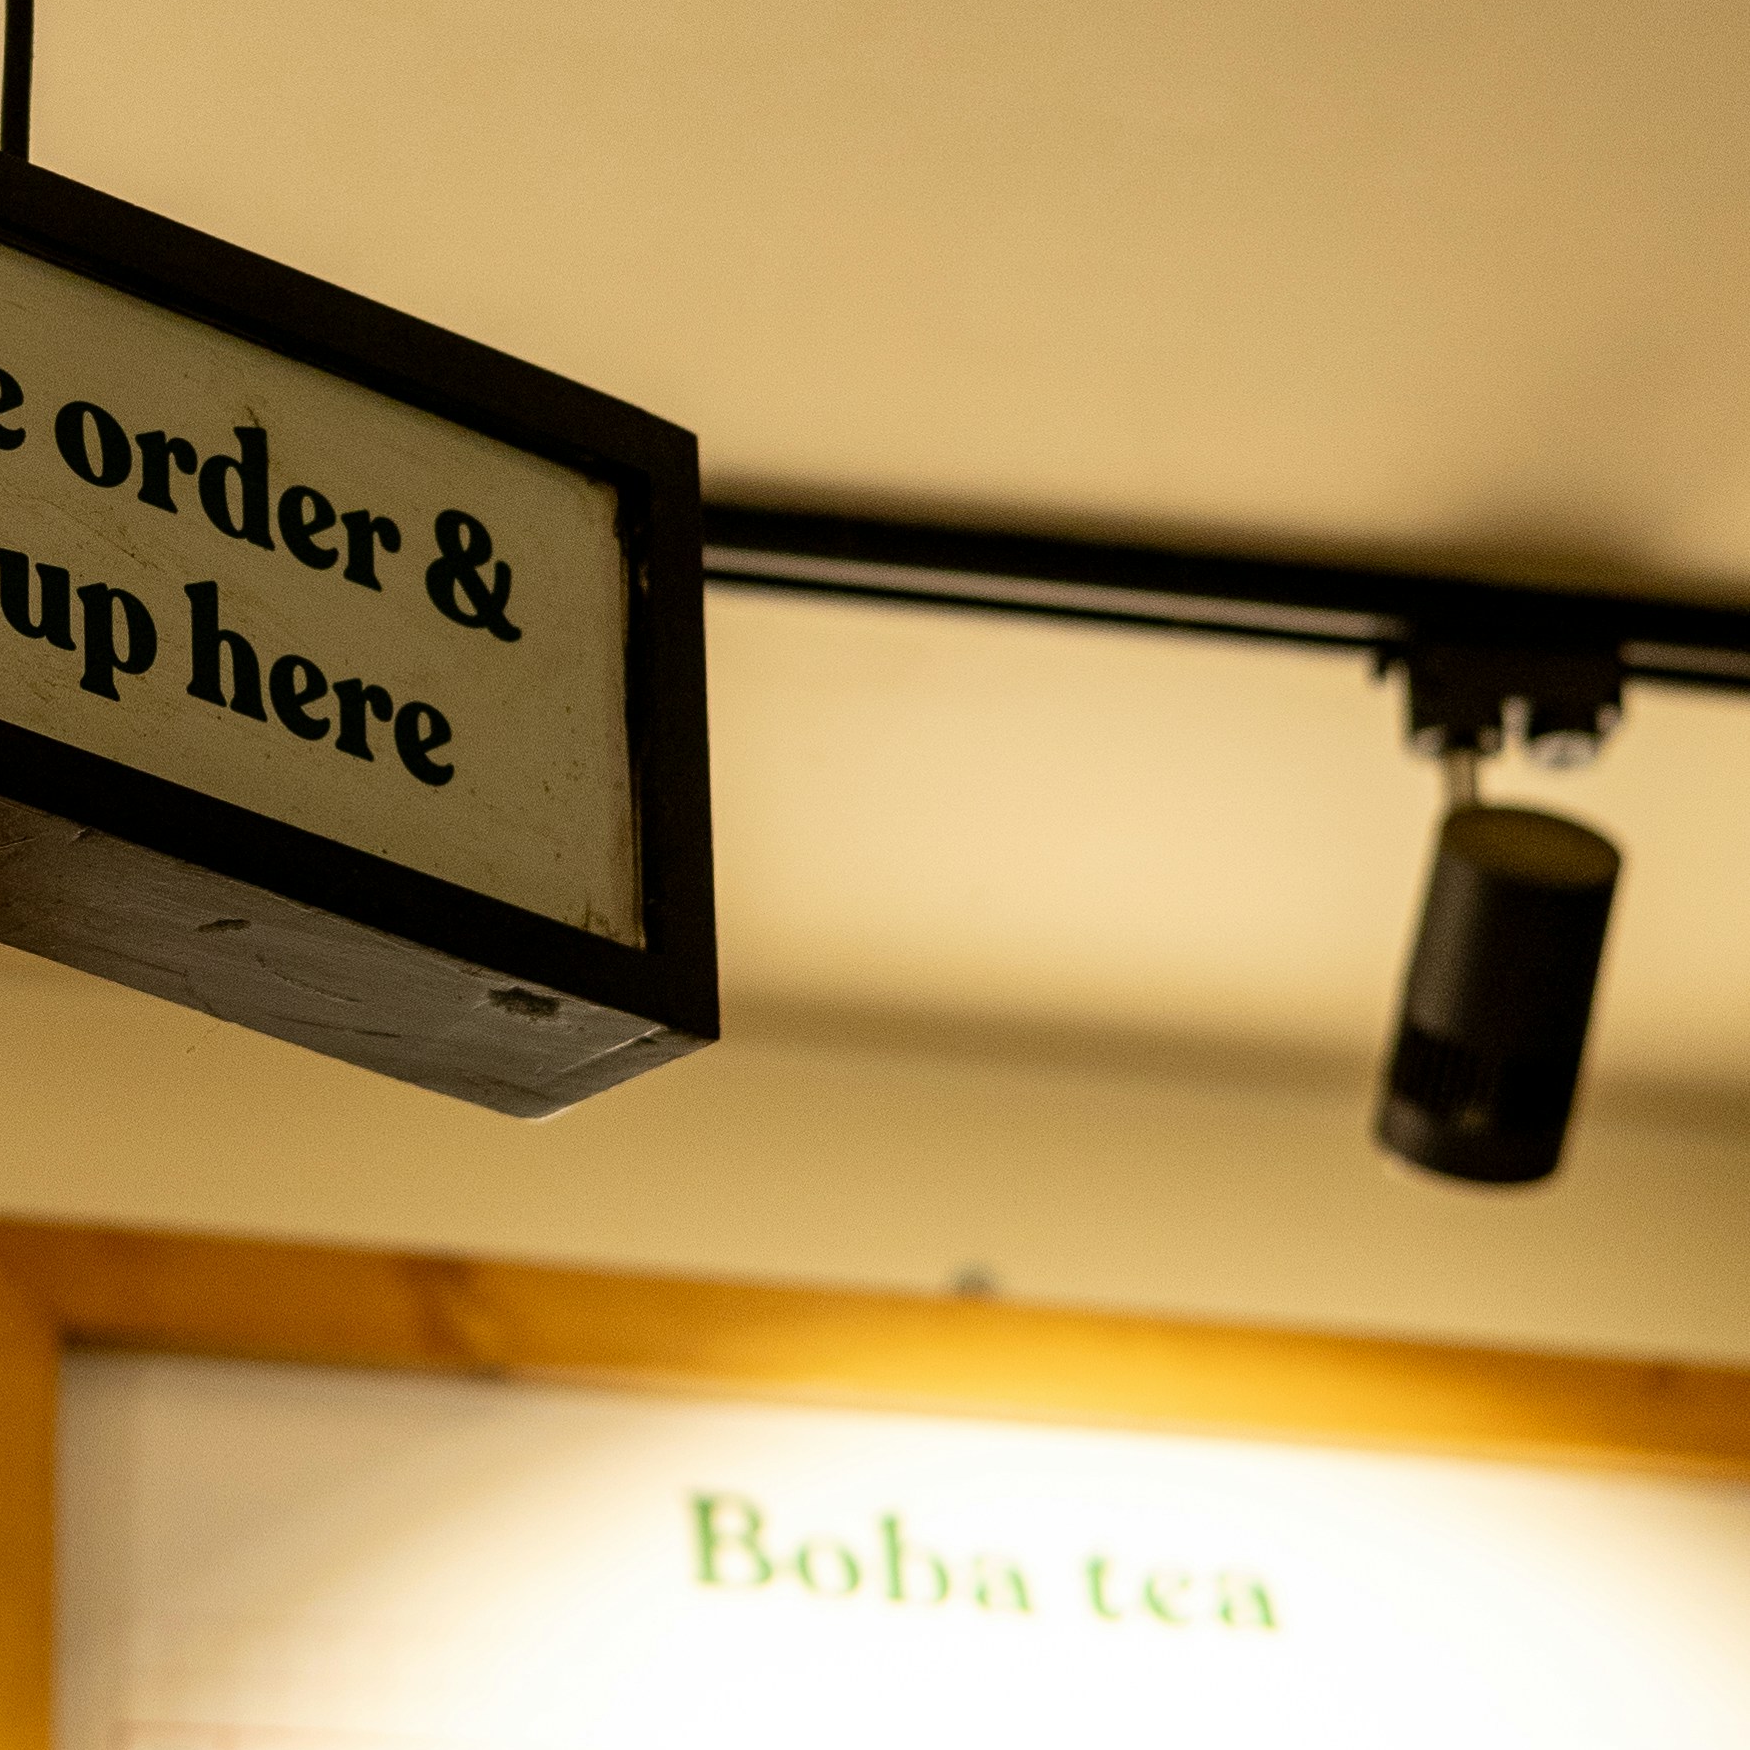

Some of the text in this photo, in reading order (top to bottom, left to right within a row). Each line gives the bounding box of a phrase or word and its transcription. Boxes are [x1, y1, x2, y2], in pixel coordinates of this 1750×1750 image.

[53, 398, 401, 592] order
[425, 507, 522, 642] &
[183, 580, 455, 786] here
[690, 1487, 1278, 1632] Boba tea
